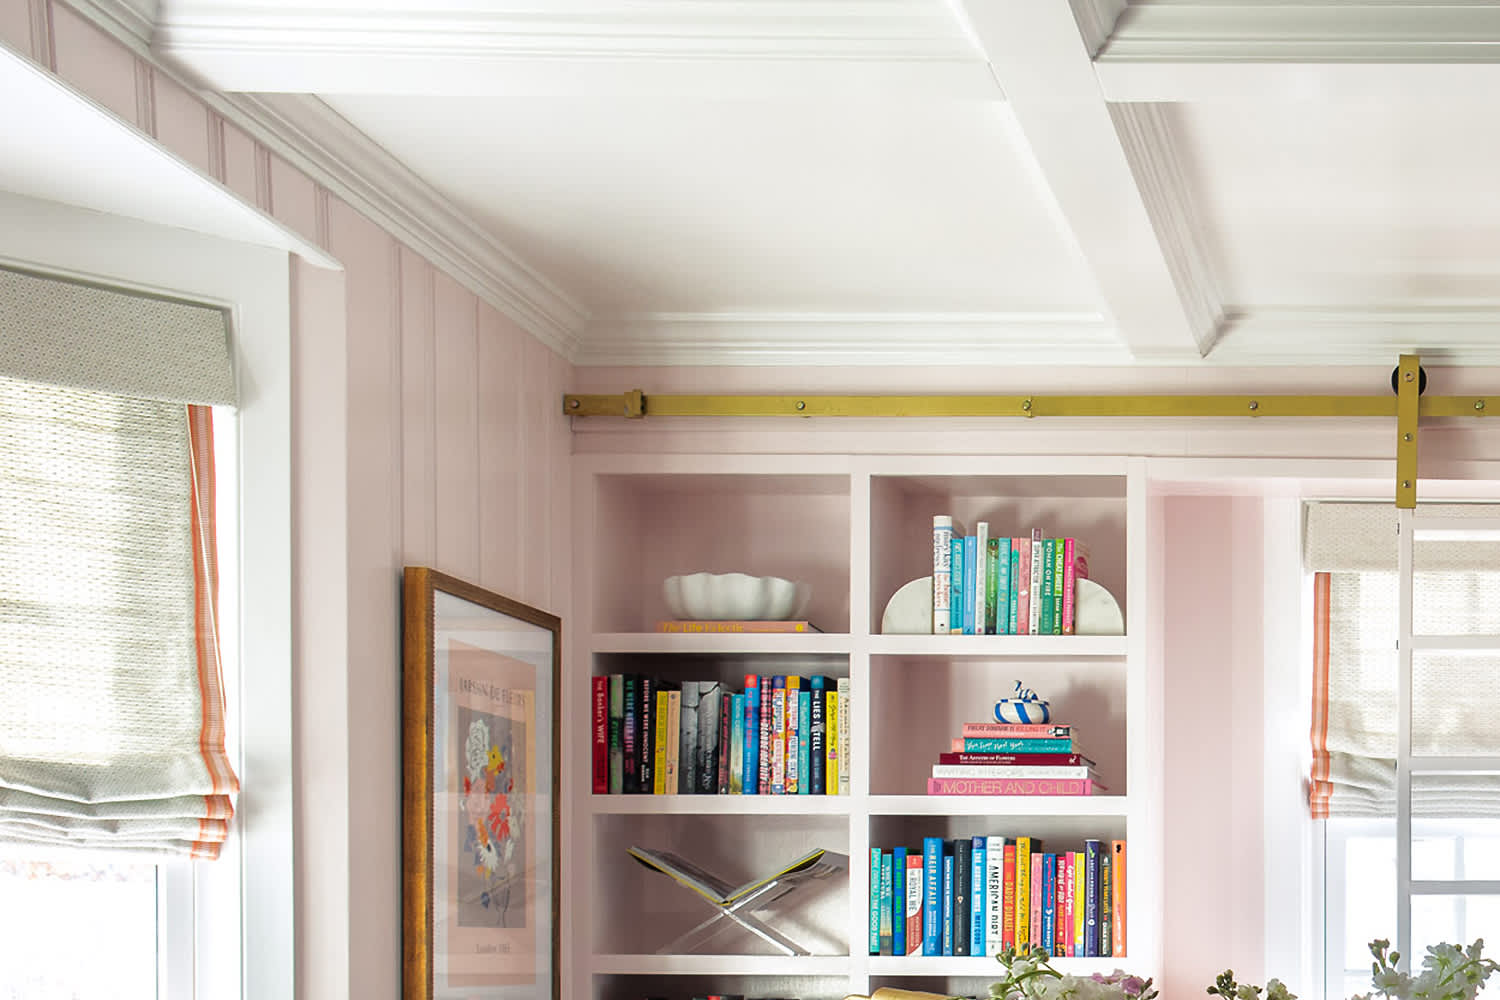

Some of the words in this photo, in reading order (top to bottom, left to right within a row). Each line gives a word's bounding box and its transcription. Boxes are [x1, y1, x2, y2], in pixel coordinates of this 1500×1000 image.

[1045, 570, 1052, 580] ON
[684, 623, 702, 632] Life
[944, 781, 1001, 794] MOTHER
[1004, 781, 1034, 794] AND
[1038, 781, 1079, 794] CHILD
[989, 865, 999, 911] AMERICAN
[909, 901, 917, 911] WE
